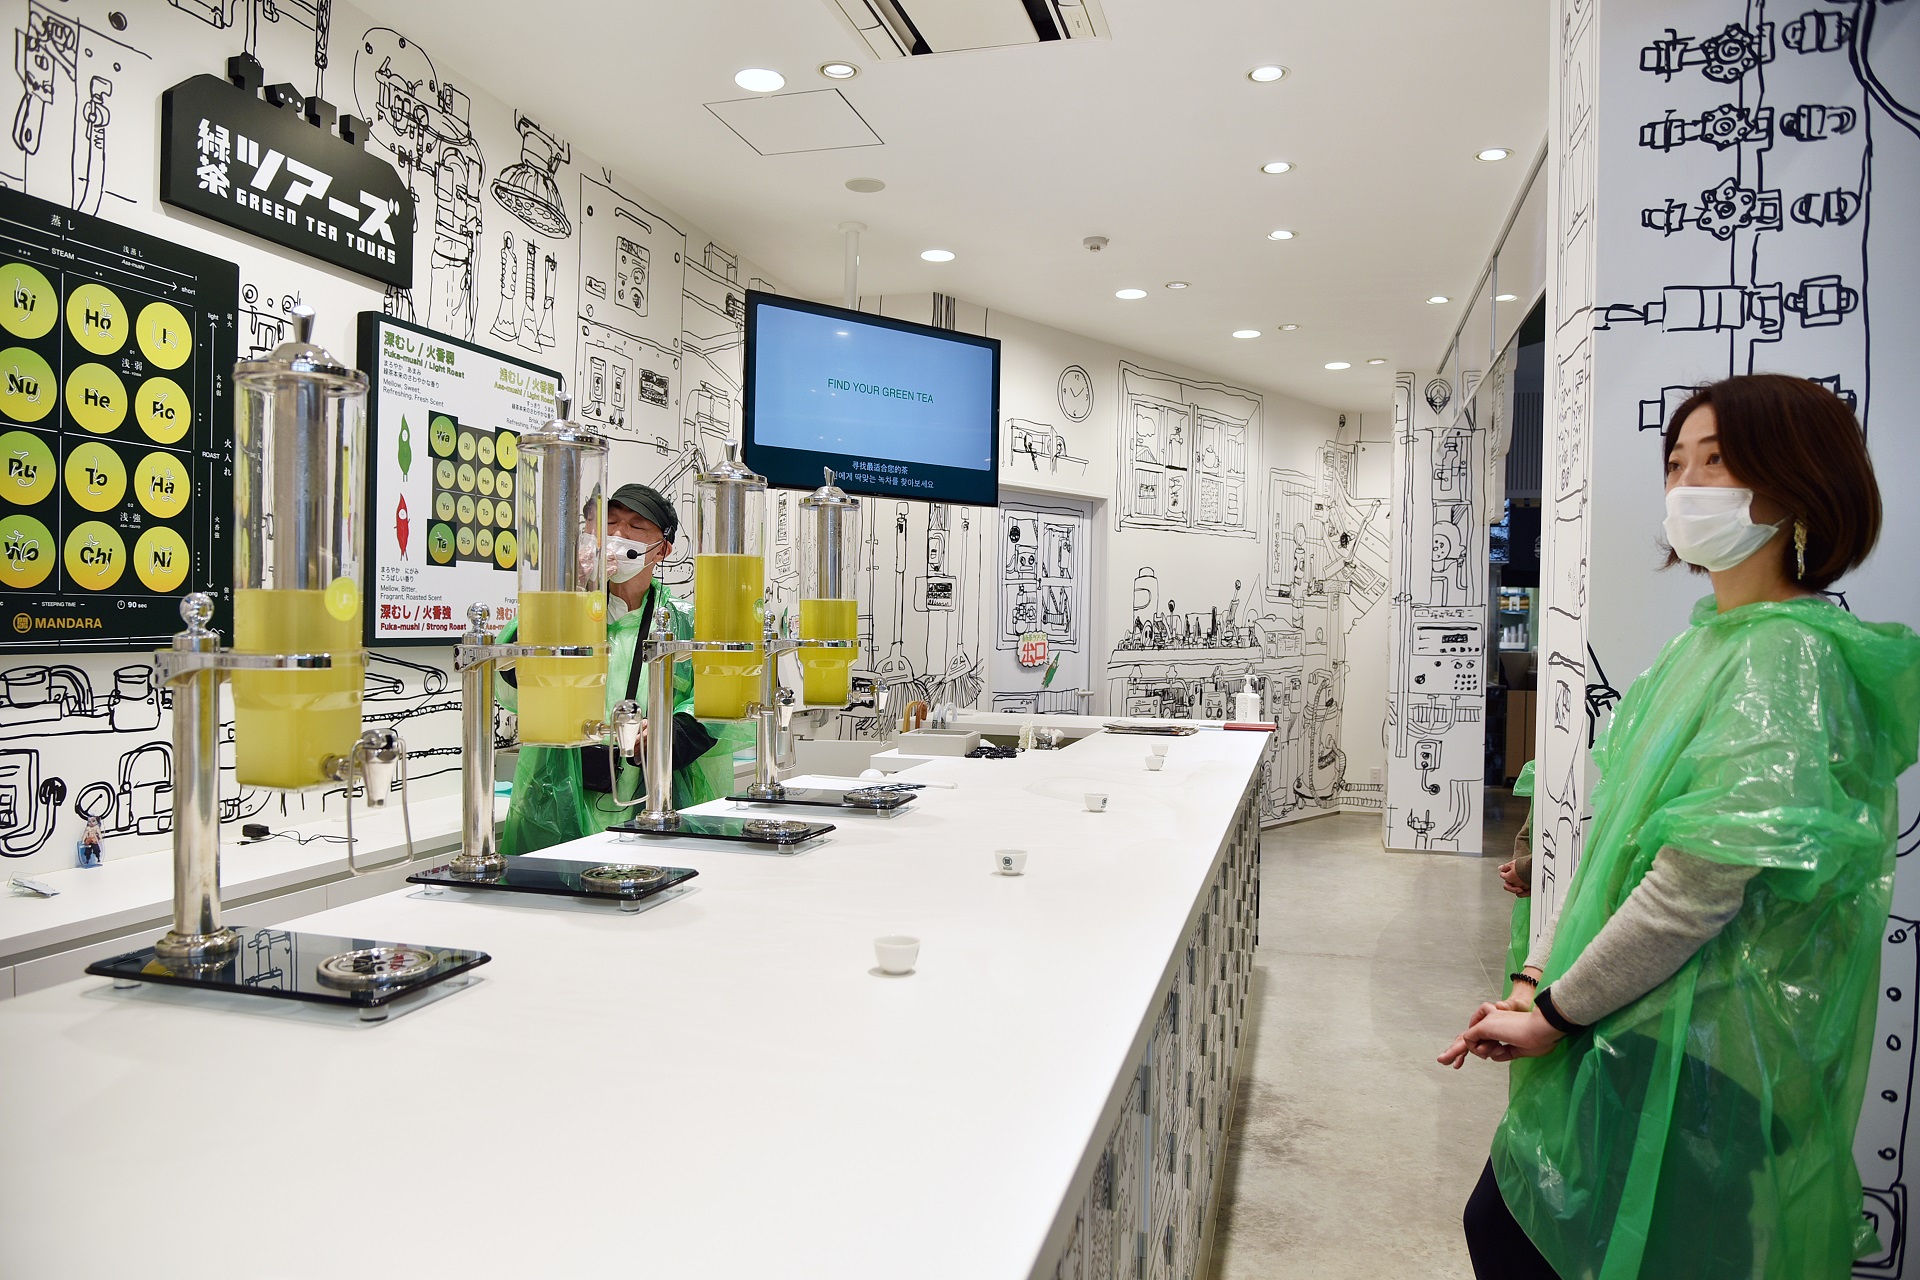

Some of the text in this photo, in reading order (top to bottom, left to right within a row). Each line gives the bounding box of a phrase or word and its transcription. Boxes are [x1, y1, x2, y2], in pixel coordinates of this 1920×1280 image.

[196, 118, 230, 199] 緑茶
[236, 134, 400, 245] ツアーズ
[50, 214, 76, 231] 蒸し
[236, 187, 396, 265] GREEN TEA TOURS
[51, 247, 75, 260] STEAM
[181, 286, 196, 295] short
[85, 308, 111, 330] Ho
[207, 312, 219, 321] light
[383, 330, 415, 353] 深むし
[383, 347, 423, 367] Fuka-mushi
[428, 361, 446, 373] Light
[446, 367, 465, 379] Roast
[383, 360, 421, 375] まろやか あまみ
[8, 373, 39, 395] Nu
[382, 378, 421, 394] Mellow, Sweet,
[827, 378, 934, 404] FIND YOUR GREEN TEA
[84, 387, 111, 409] He
[382, 386, 445, 407] Refreshing, Fresh Scent
[494, 381, 523, 396] Asa-mushi
[526, 390, 540, 401] Light
[540, 394, 555, 405] Roast
[152, 400, 175, 419] Ro
[201, 450, 221, 460] ROAST
[223, 438, 232, 477] 火入れ
[482, 446, 491, 454] Ho
[85, 467, 108, 486] To
[151, 475, 175, 494] Ha
[854, 473, 877, 484] 딱맞는
[877, 475, 899, 486] 녹차를
[900, 477, 935, 489] 찾아보세요
[442, 502, 450, 511] Yo
[80, 546, 113, 565] Chi
[153, 551, 172, 567] Ni
[380, 566, 419, 575] まろやか にがみ
[380, 574, 414, 583] こうばしい香り
[380, 584, 418, 593] Mellow, Bitter,
[127, 601, 137, 609] 90
[380, 592, 405, 602] Fragrant,
[405, 593, 427, 601] Roasted
[380, 604, 412, 620] 深むし
[34, 617, 103, 629] MANDARA
[380, 622, 420, 631] Fuka-mushi
[426, 622, 448, 632] Strong
[448, 622, 467, 631] Roast
[1021, 641, 1046, 663] 出口
